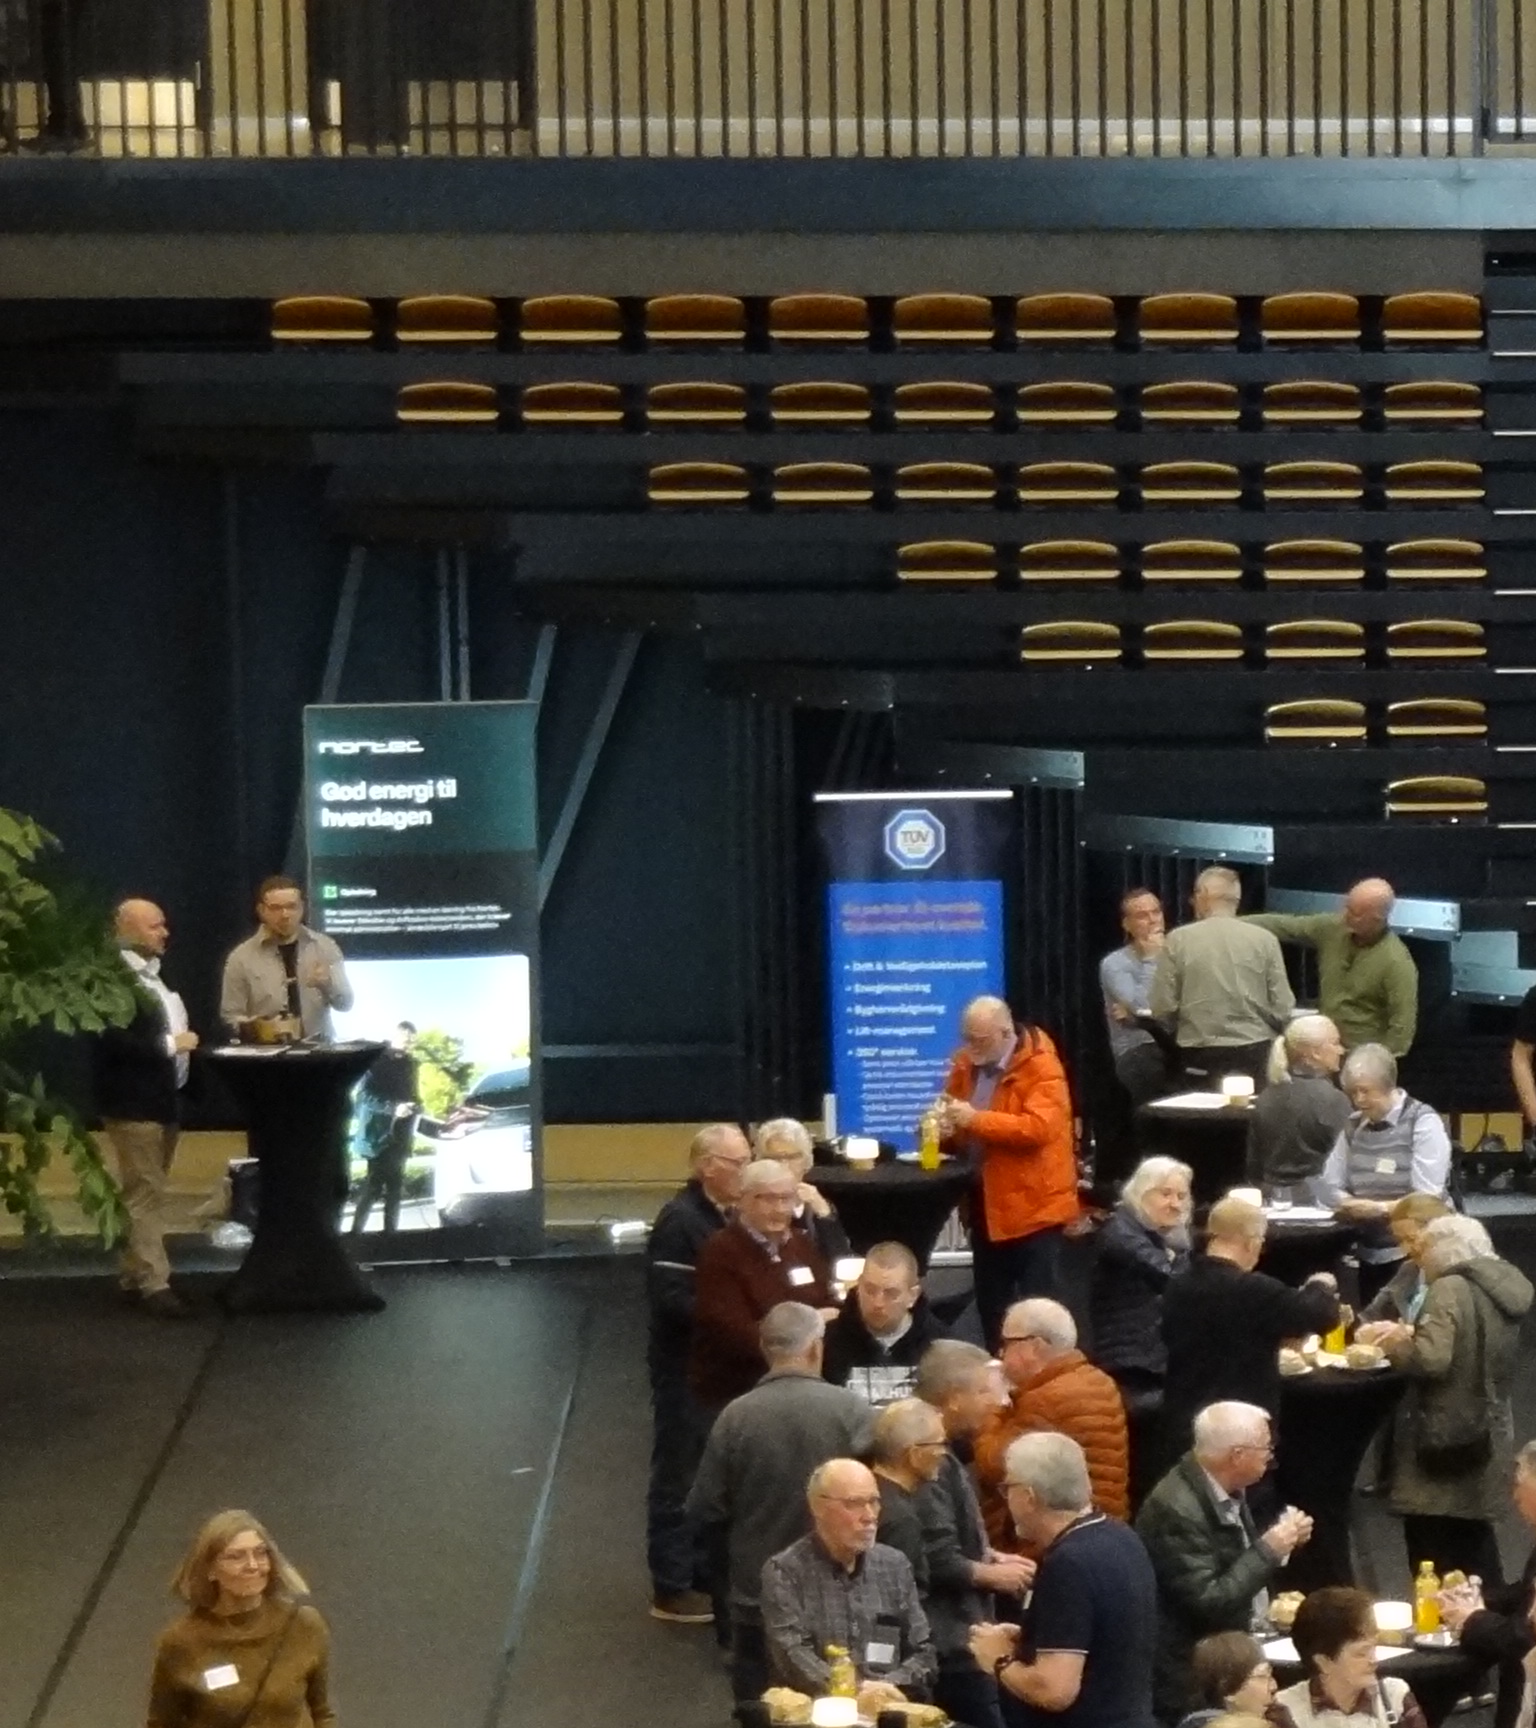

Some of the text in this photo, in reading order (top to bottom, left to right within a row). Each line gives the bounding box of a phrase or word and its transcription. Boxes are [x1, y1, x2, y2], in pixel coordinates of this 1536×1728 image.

[319, 740, 424, 754] nortec
[321, 779, 457, 803] God energi til
[322, 807, 432, 830] hverdagen
